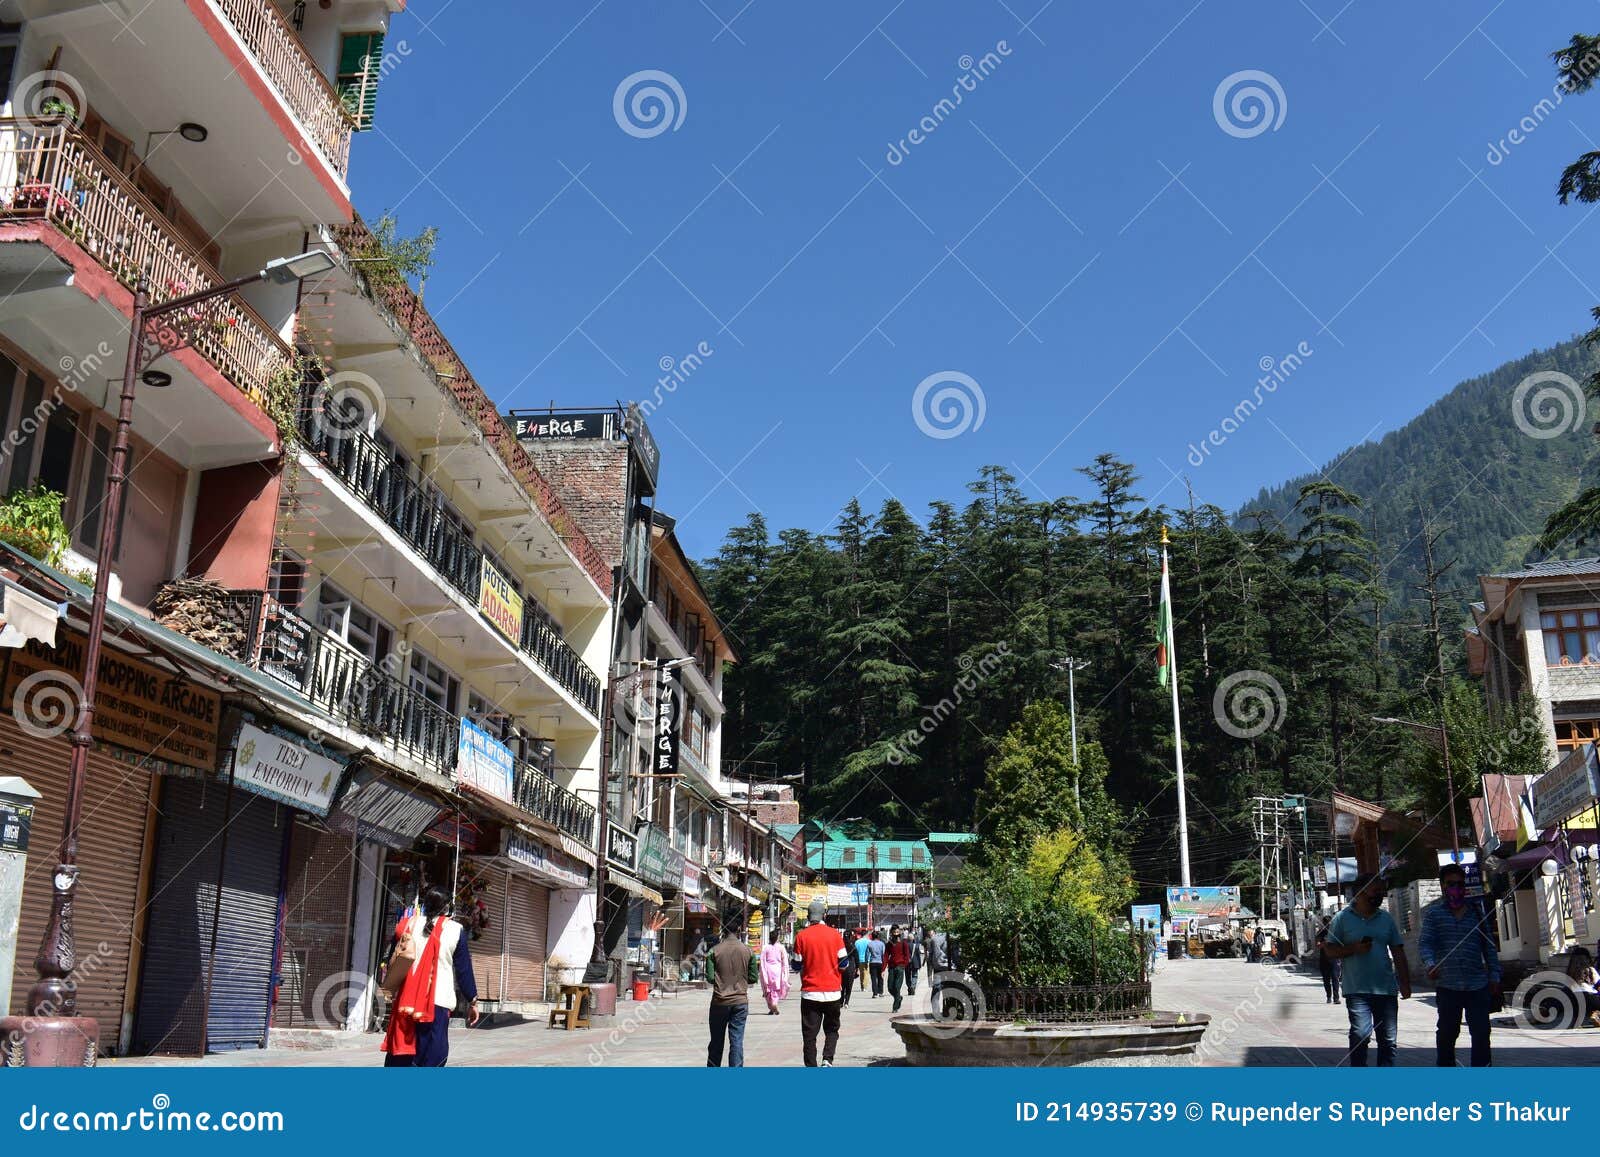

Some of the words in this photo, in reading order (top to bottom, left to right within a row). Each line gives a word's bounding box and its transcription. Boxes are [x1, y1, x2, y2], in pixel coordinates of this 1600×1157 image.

[484, 562, 510, 605] HOTEL
[482, 589, 520, 642] ADARSH
[98, 654, 158, 702] HOPPING
[161, 682, 215, 723] ARCADE
[276, 743, 309, 770] TIBET
[252, 761, 313, 798] EMPORIUM
